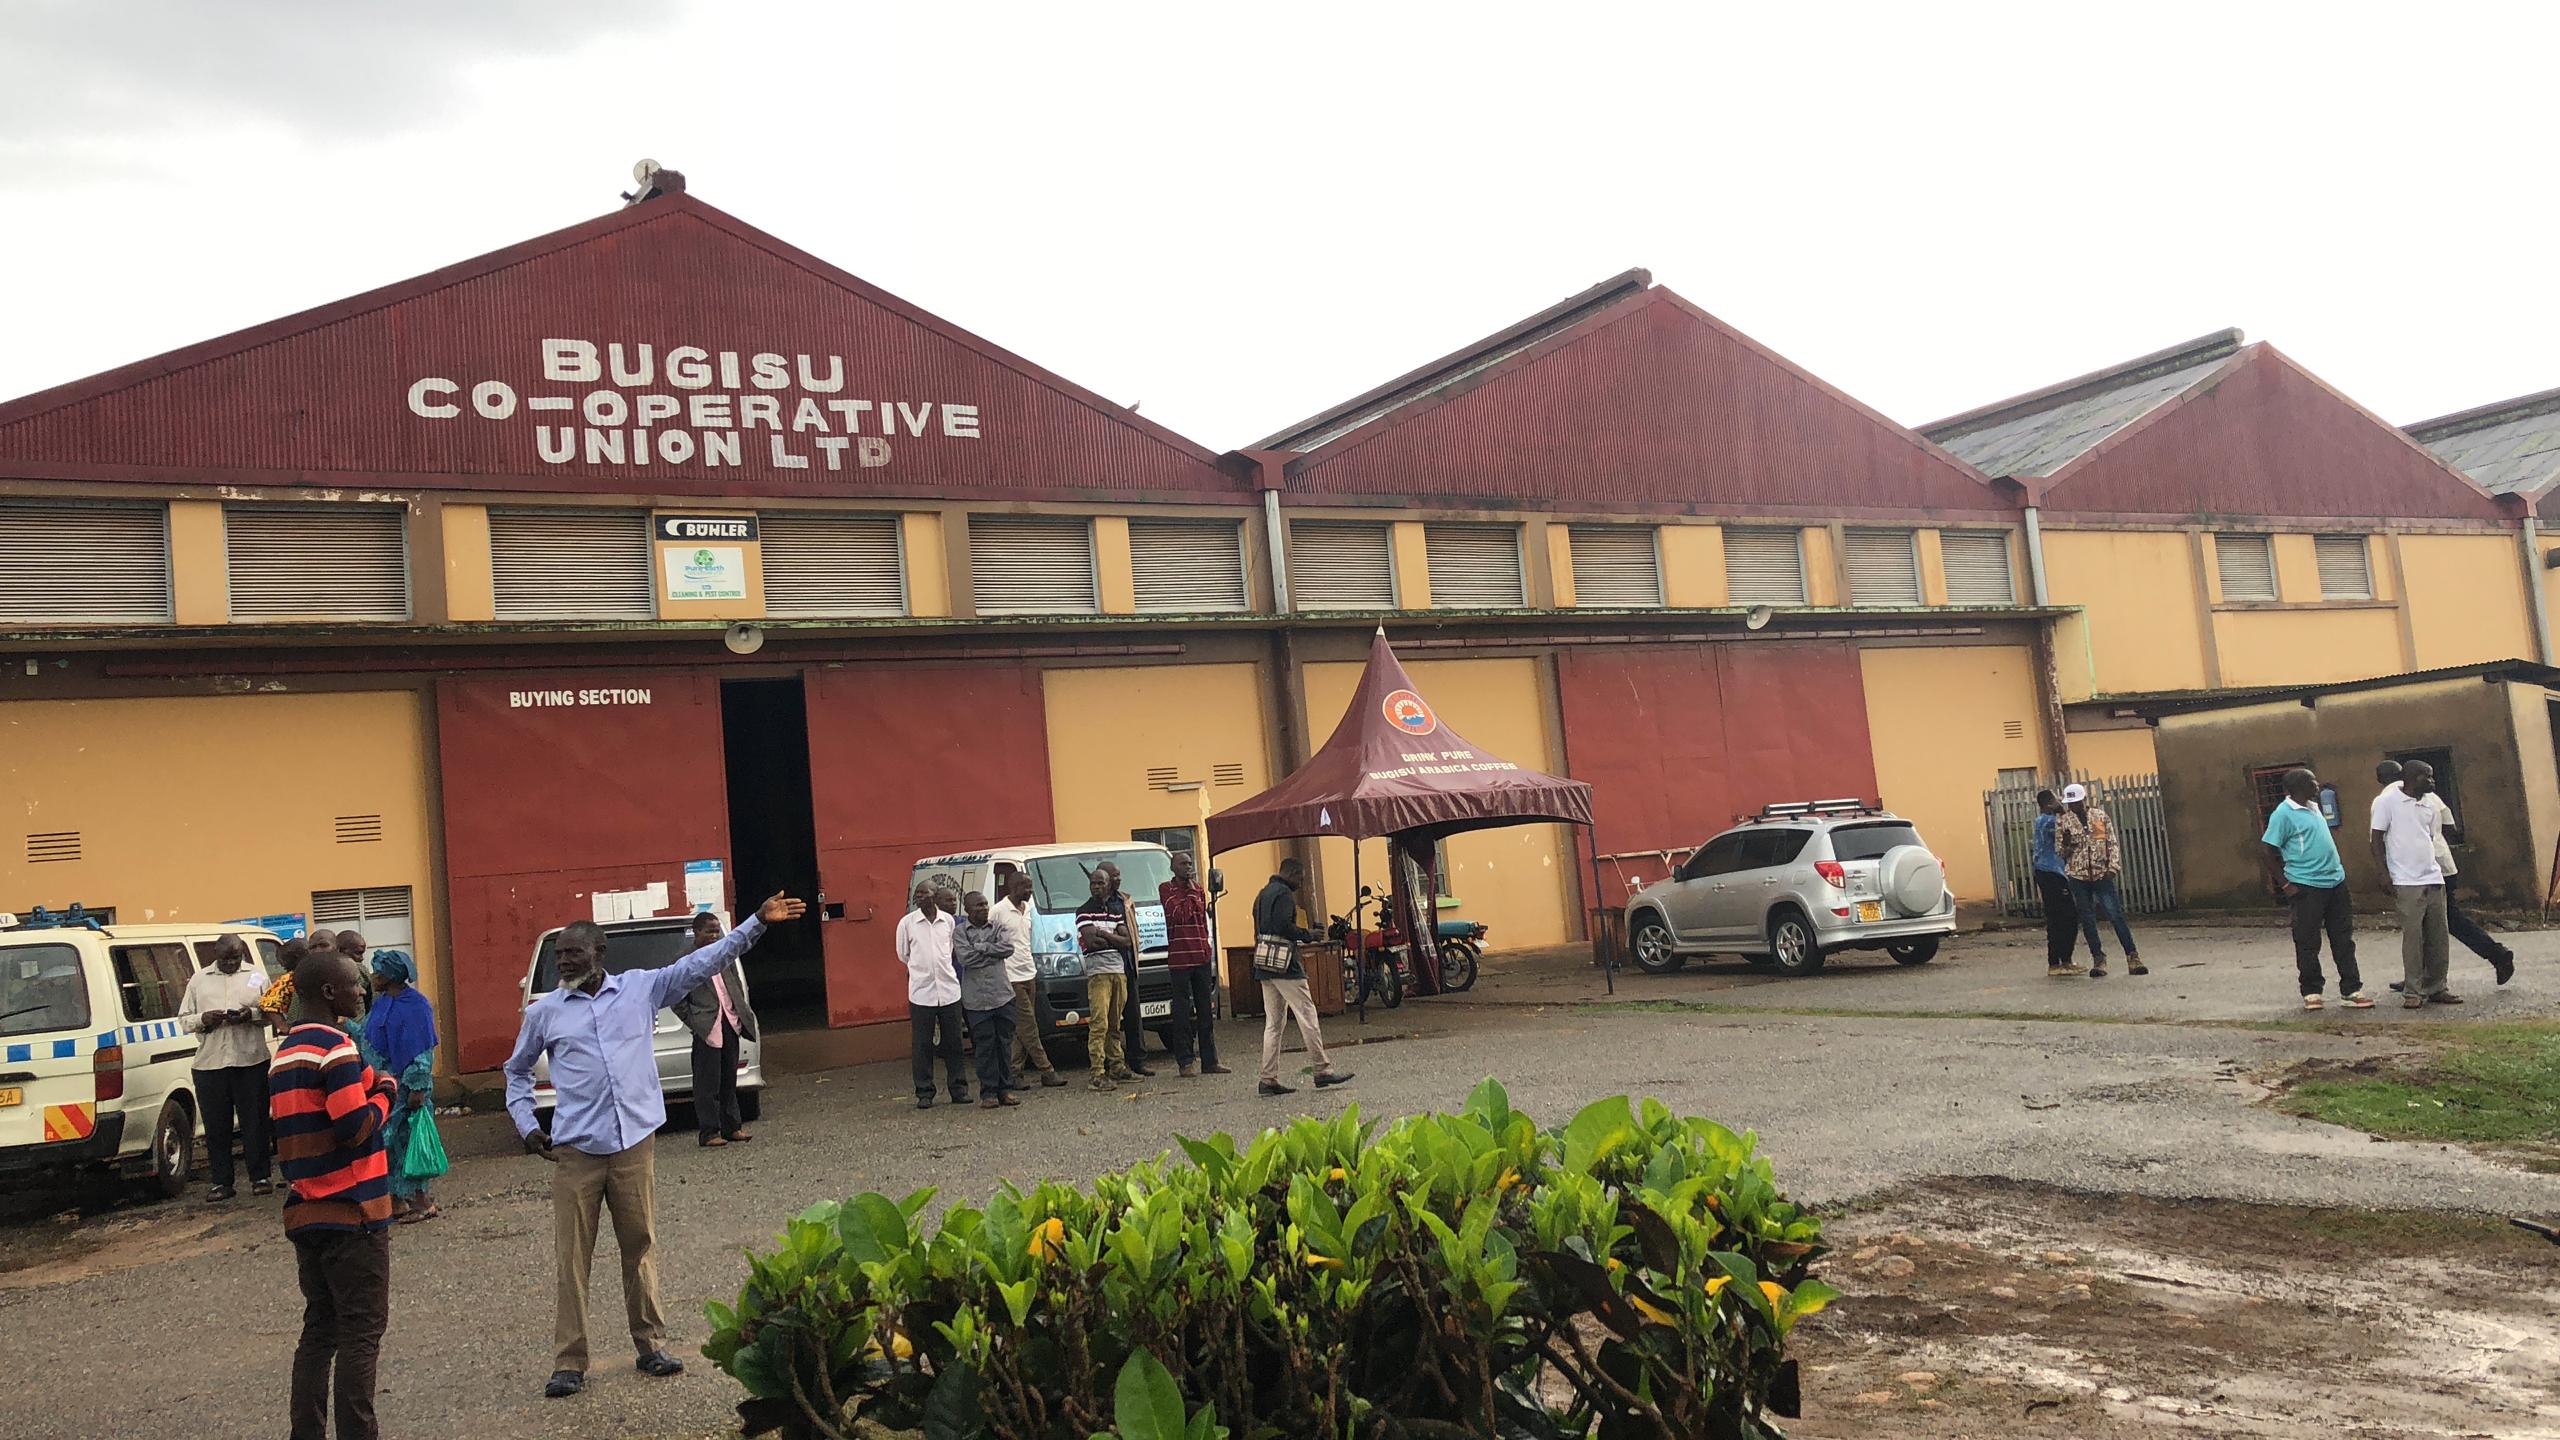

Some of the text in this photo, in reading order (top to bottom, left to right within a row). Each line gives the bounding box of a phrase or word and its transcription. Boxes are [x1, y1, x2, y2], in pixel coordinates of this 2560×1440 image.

[541, 338, 844, 393] BUGISU
[407, 377, 981, 439] CO-OPERATIVE
[536, 425, 892, 470] UNION LTD
[509, 688, 652, 708] BUYING SECTION
[1369, 762, 1518, 780] BUGISU ARABICA COFFEE
[1401, 750, 1474, 762] DRINK PURE
